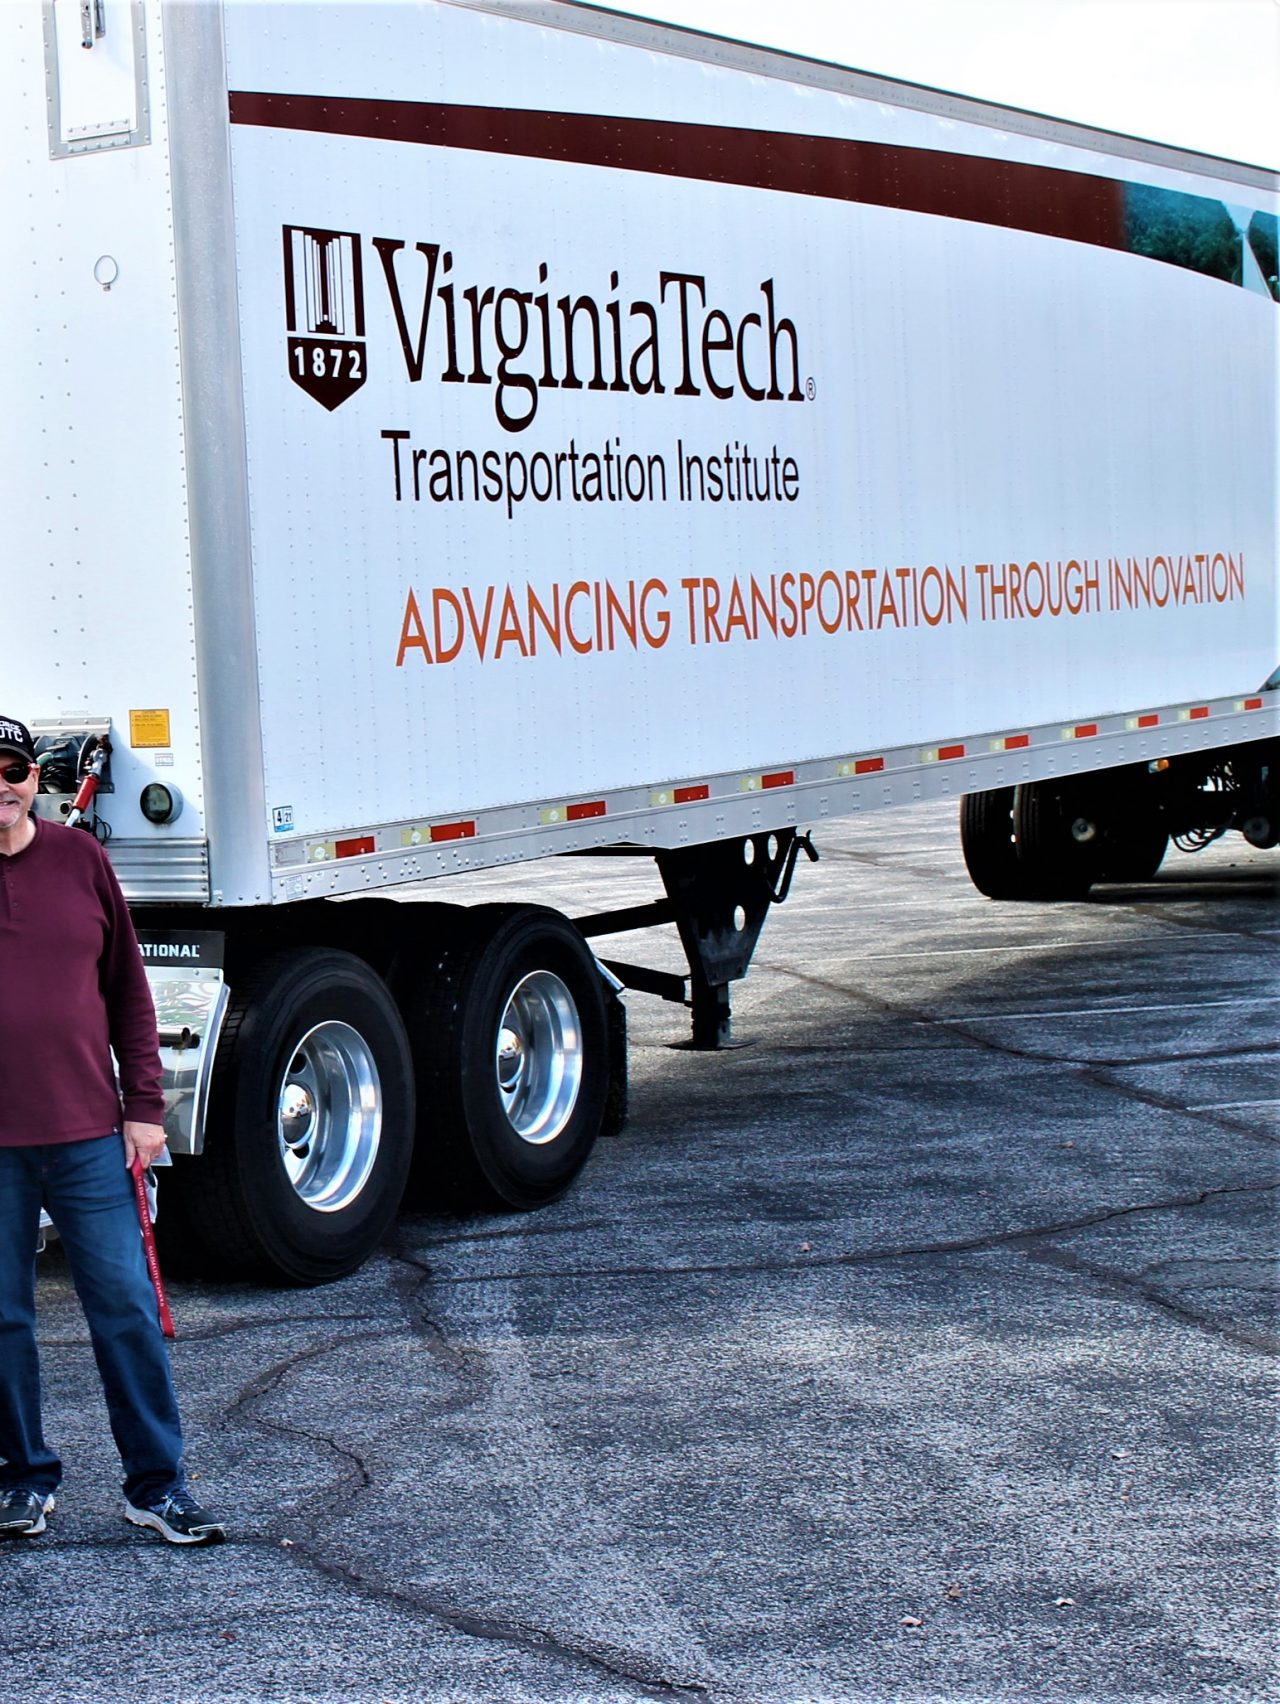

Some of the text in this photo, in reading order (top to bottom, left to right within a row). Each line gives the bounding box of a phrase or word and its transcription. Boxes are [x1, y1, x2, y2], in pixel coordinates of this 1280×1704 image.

[293, 345, 362, 380] 1872
[380, 429, 800, 519] Transportation Institute
[396, 552, 1246, 667] ADVANCING TRANSPORTATION THROUGH INNOVATION
